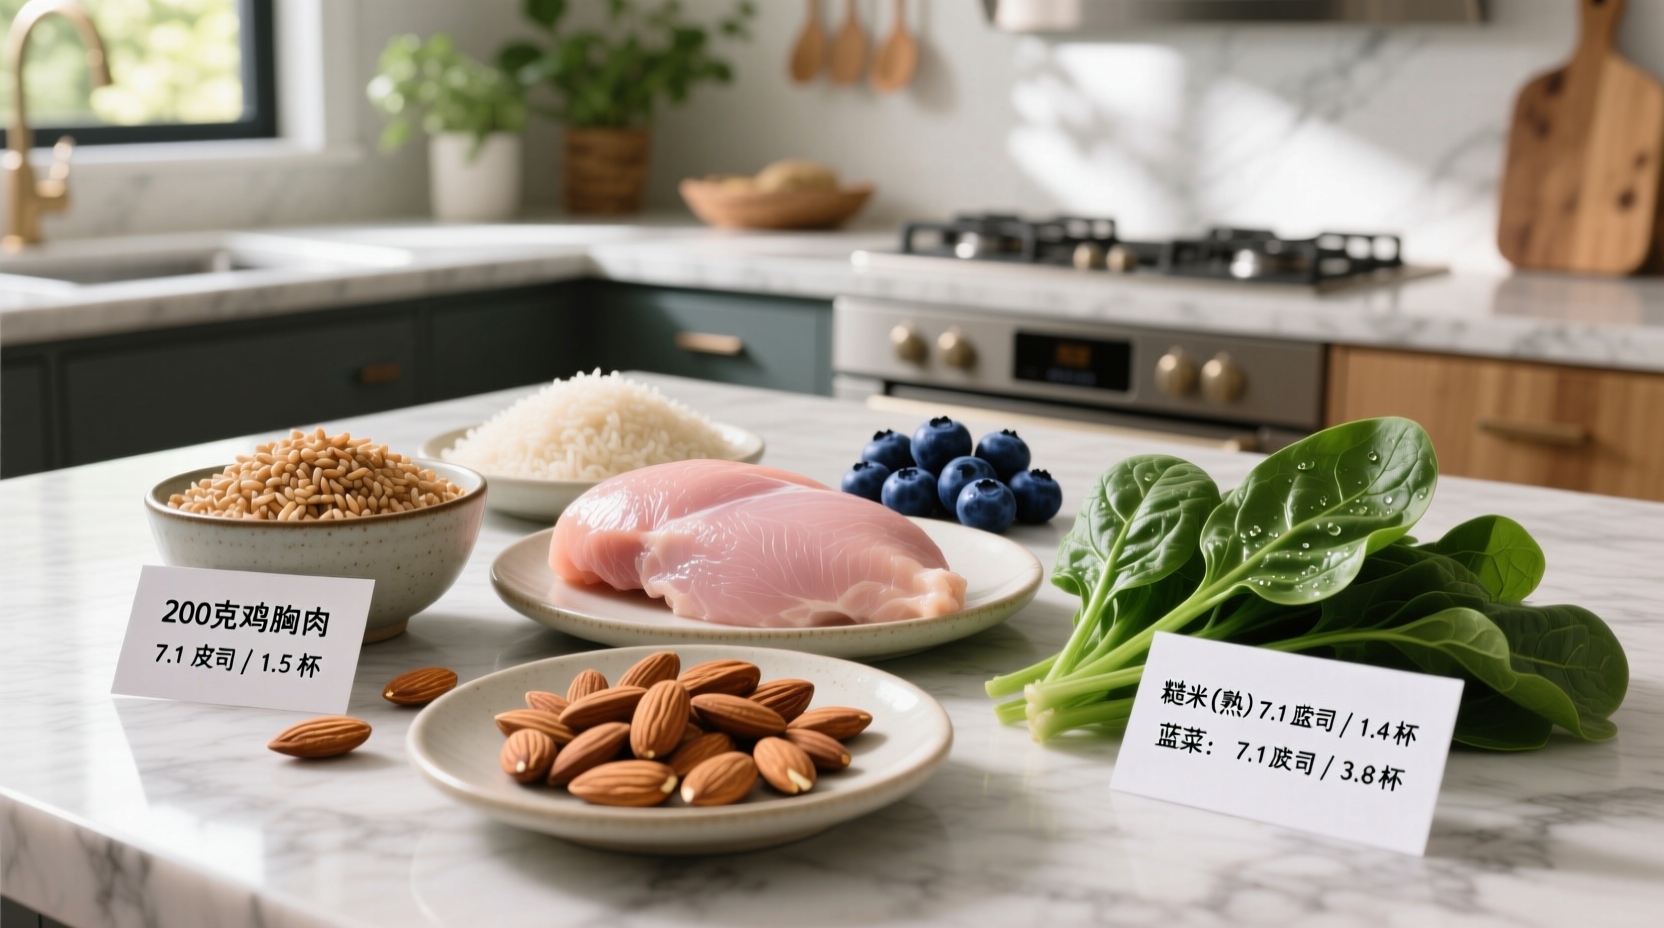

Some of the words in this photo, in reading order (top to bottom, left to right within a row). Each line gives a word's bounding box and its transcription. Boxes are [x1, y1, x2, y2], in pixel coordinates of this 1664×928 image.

[161, 599, 330, 636] 200克鸡胸肉
[155, 643, 184, 664] 7.1
[190, 643, 236, 672] 皮司
[240, 648, 254, 675] /
[262, 653, 293, 673] 1.5
[296, 652, 323, 679] 杯
